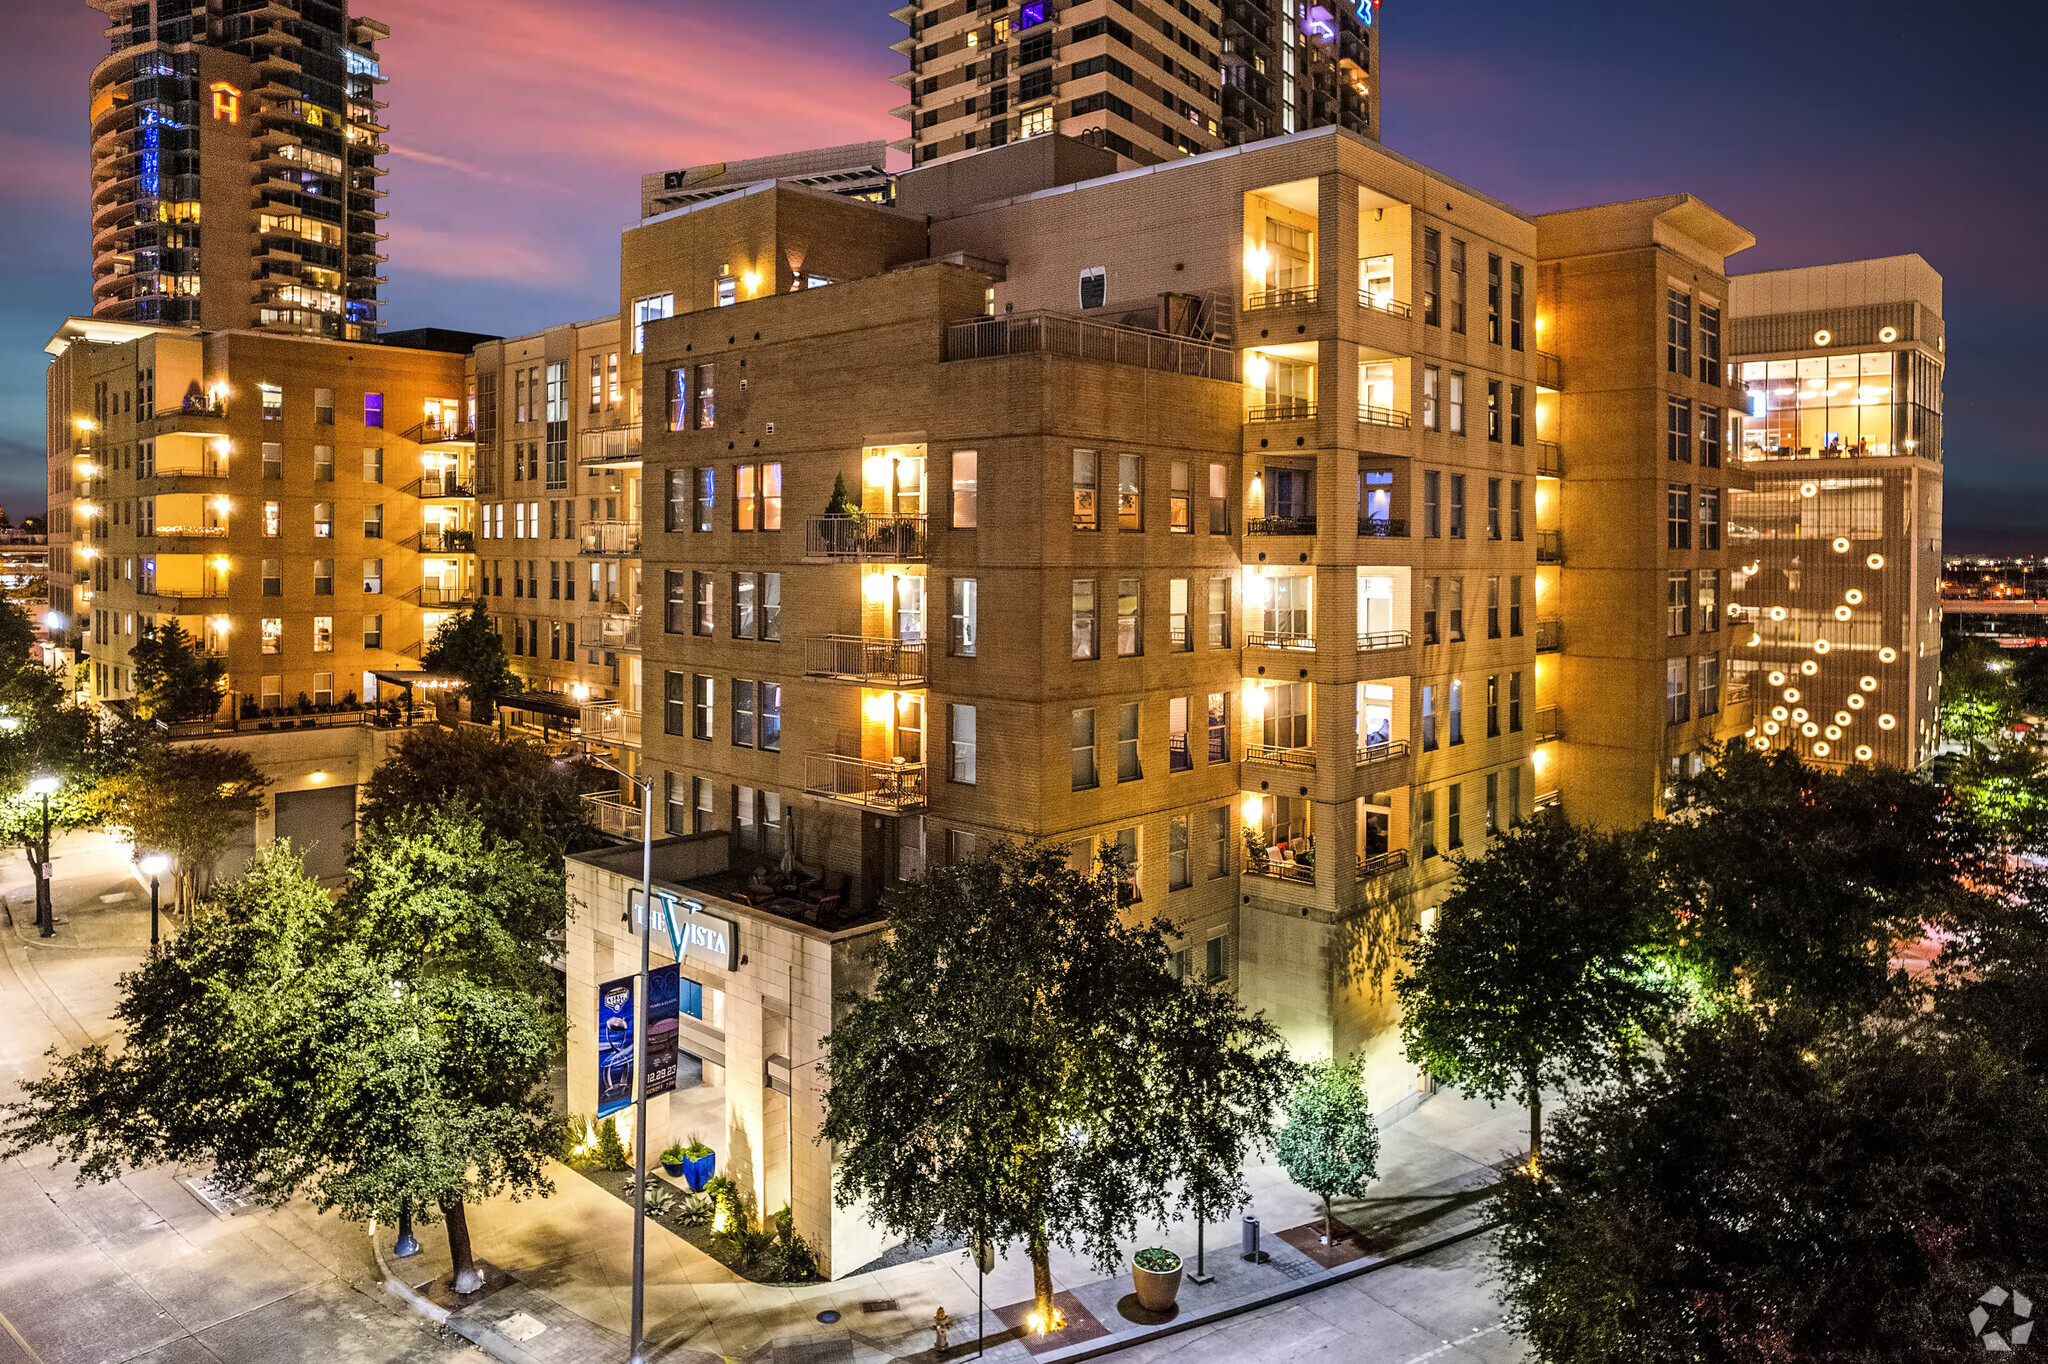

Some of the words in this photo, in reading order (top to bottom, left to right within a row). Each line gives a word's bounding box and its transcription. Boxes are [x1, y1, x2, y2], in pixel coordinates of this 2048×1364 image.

[664, 171, 686, 190] EY
[634, 903, 666, 933] THE
[657, 891, 727, 963] VISTA
[646, 1064, 677, 1084] 12.29.23
